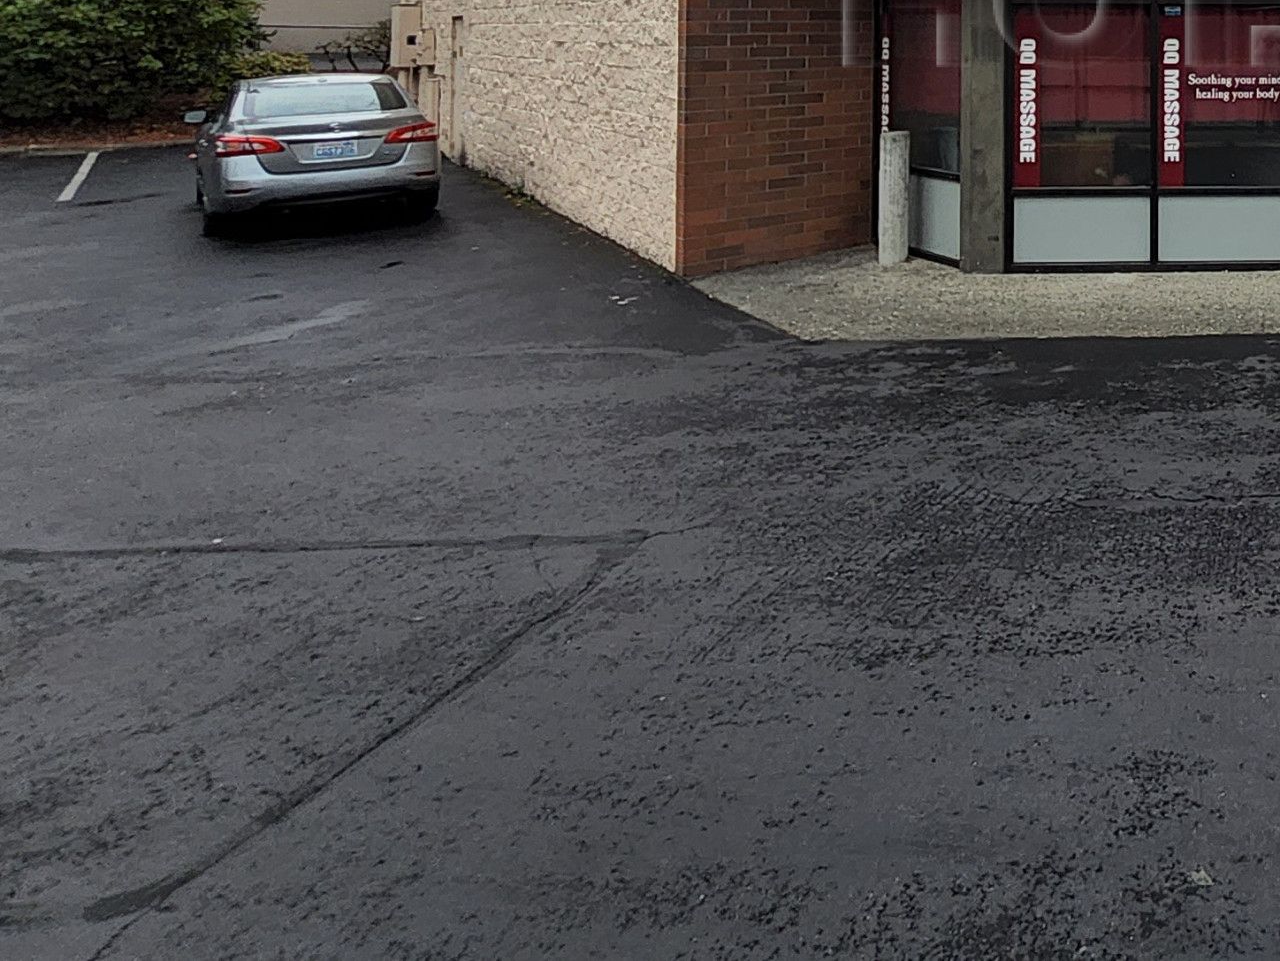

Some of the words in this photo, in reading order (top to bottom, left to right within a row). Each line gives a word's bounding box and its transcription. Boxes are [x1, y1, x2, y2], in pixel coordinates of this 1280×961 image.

[880, 37, 890, 60] QQ
[1019, 38, 1037, 65] QQ
[1162, 38, 1180, 65] QQ
[1187, 73, 1232, 88] Soothing
[1234, 77, 1256, 88] your
[880, 64, 891, 135] MASSAG
[1195, 87, 1230, 102] healing
[1232, 90, 1254, 102] your
[1256, 87, 1280, 103] body
[1019, 69, 1037, 163] MASSAGE
[1162, 69, 1180, 162] MASSAGE
